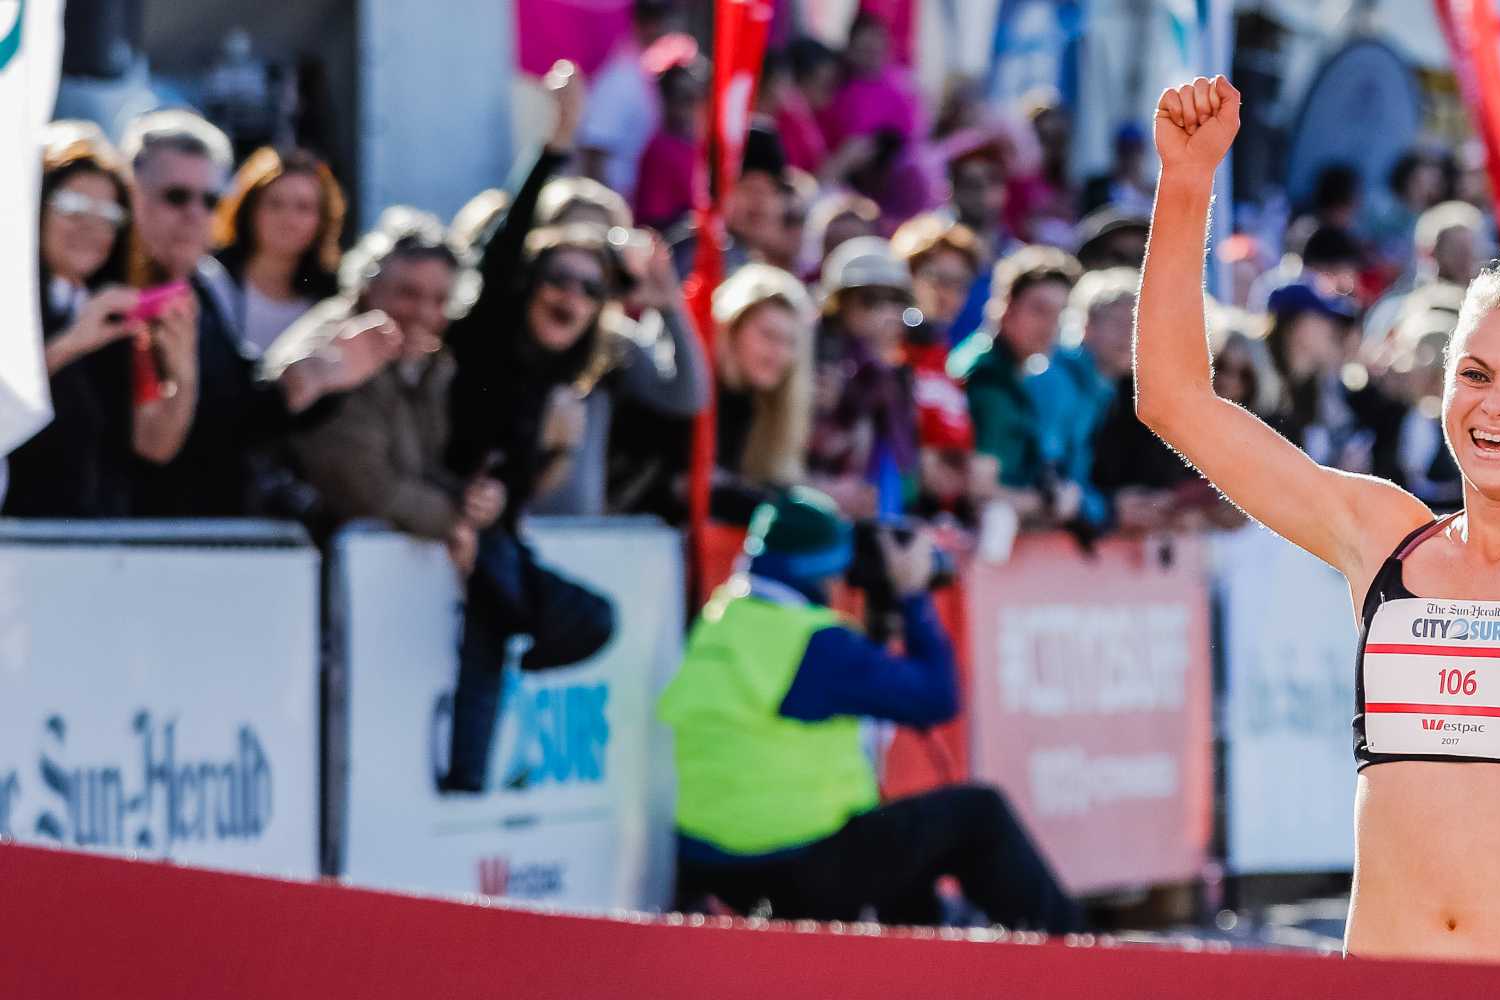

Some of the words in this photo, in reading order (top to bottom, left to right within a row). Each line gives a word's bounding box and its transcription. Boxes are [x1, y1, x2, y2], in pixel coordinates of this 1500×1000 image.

[1426, 603, 1446, 615] The
[1438, 668, 1479, 696] 106
[1421, 718, 1486, 735] Westpac
[1441, 737, 1460, 745] 2017
